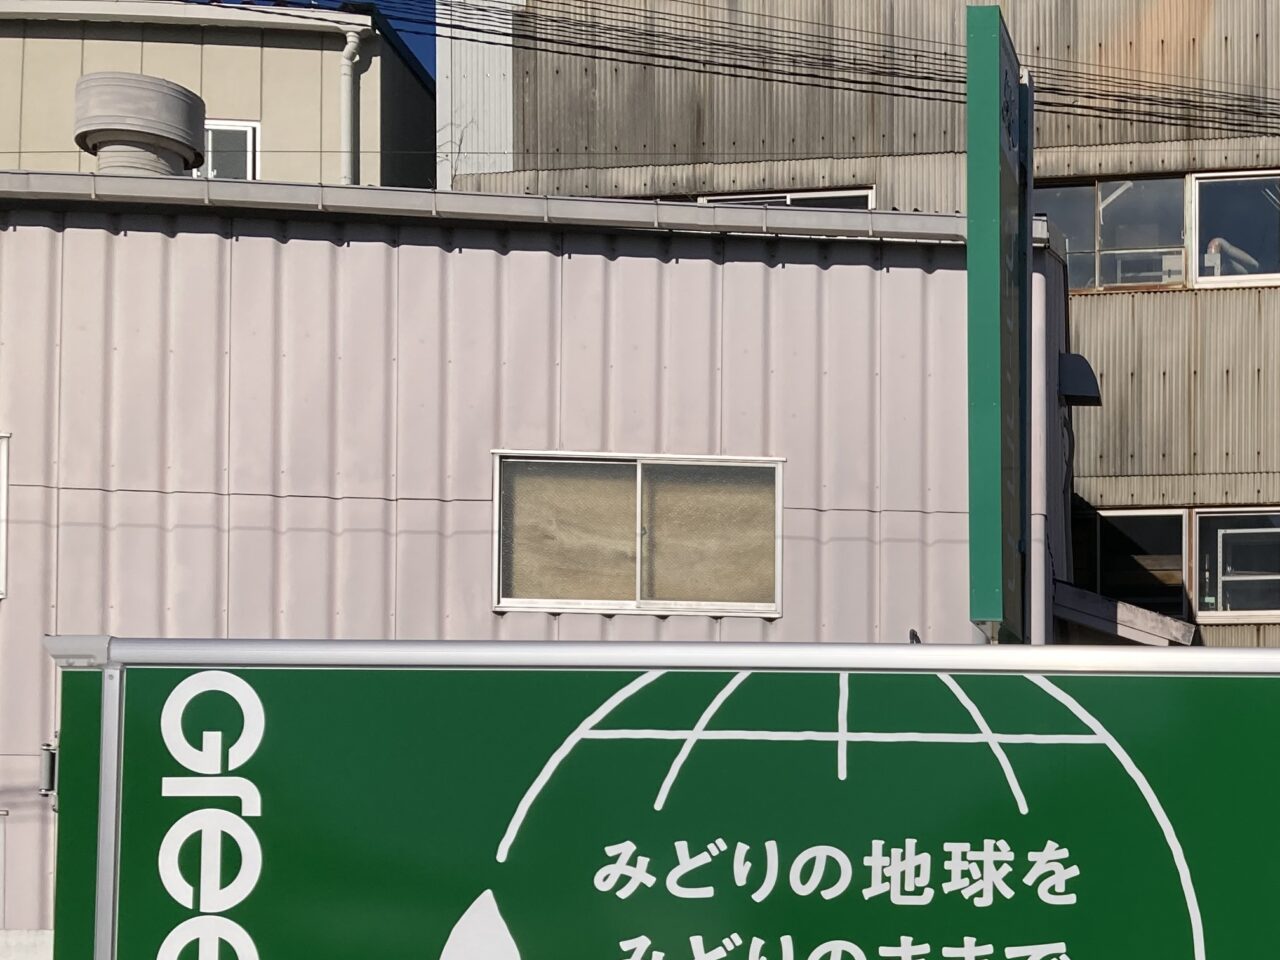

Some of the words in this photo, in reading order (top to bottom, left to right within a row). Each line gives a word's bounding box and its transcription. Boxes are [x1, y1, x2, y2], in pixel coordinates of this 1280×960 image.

[593, 837, 1080, 908] みどりの地球を
